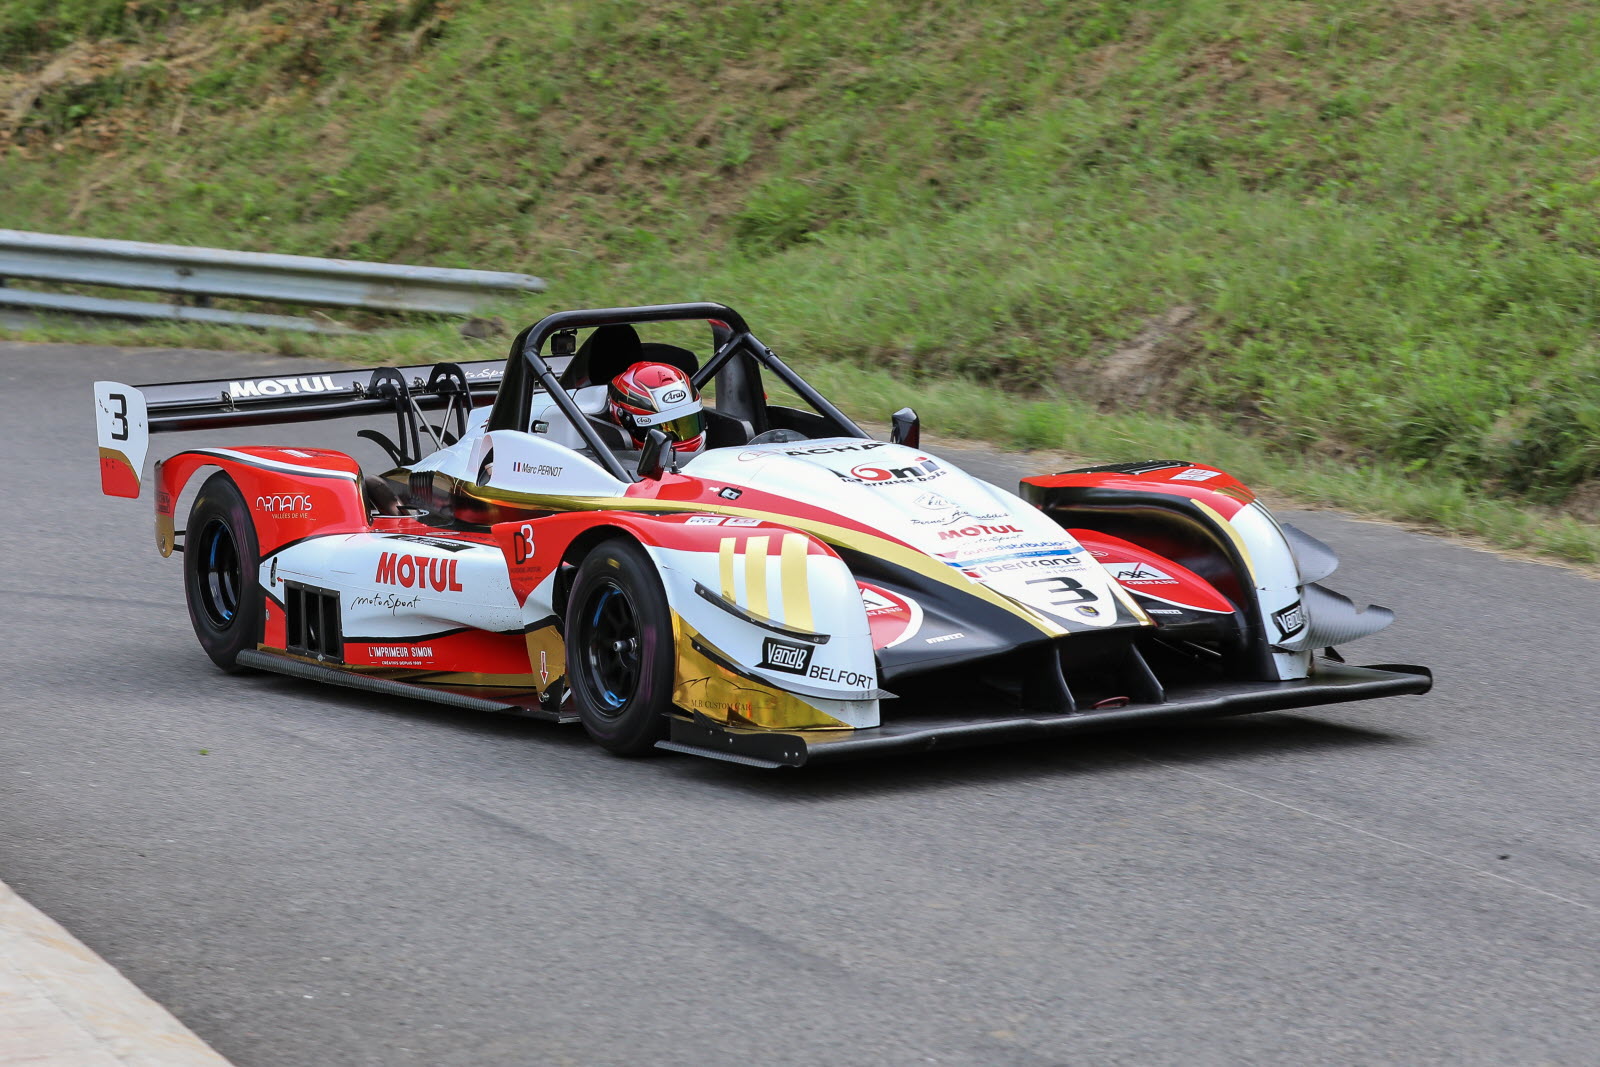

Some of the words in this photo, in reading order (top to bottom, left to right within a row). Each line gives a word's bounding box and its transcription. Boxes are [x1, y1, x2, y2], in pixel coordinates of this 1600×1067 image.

[229, 376, 343, 398] MOTUL
[665, 391, 684, 402] Arai
[109, 393, 129, 441] 3
[522, 462, 537, 474] Marc
[537, 464, 563, 478] PERNOT
[938, 525, 1023, 540] MOTUL
[375, 551, 463, 593] MOTUL
[1117, 570, 1159, 579] AXA
[1025, 576, 1098, 606] 3
[866, 606, 903, 617] NANS
[368, 646, 409, 658] L'IMPRIMEUR
[411, 646, 433, 658] SIMON
[809, 665, 873, 690] BELFORT
